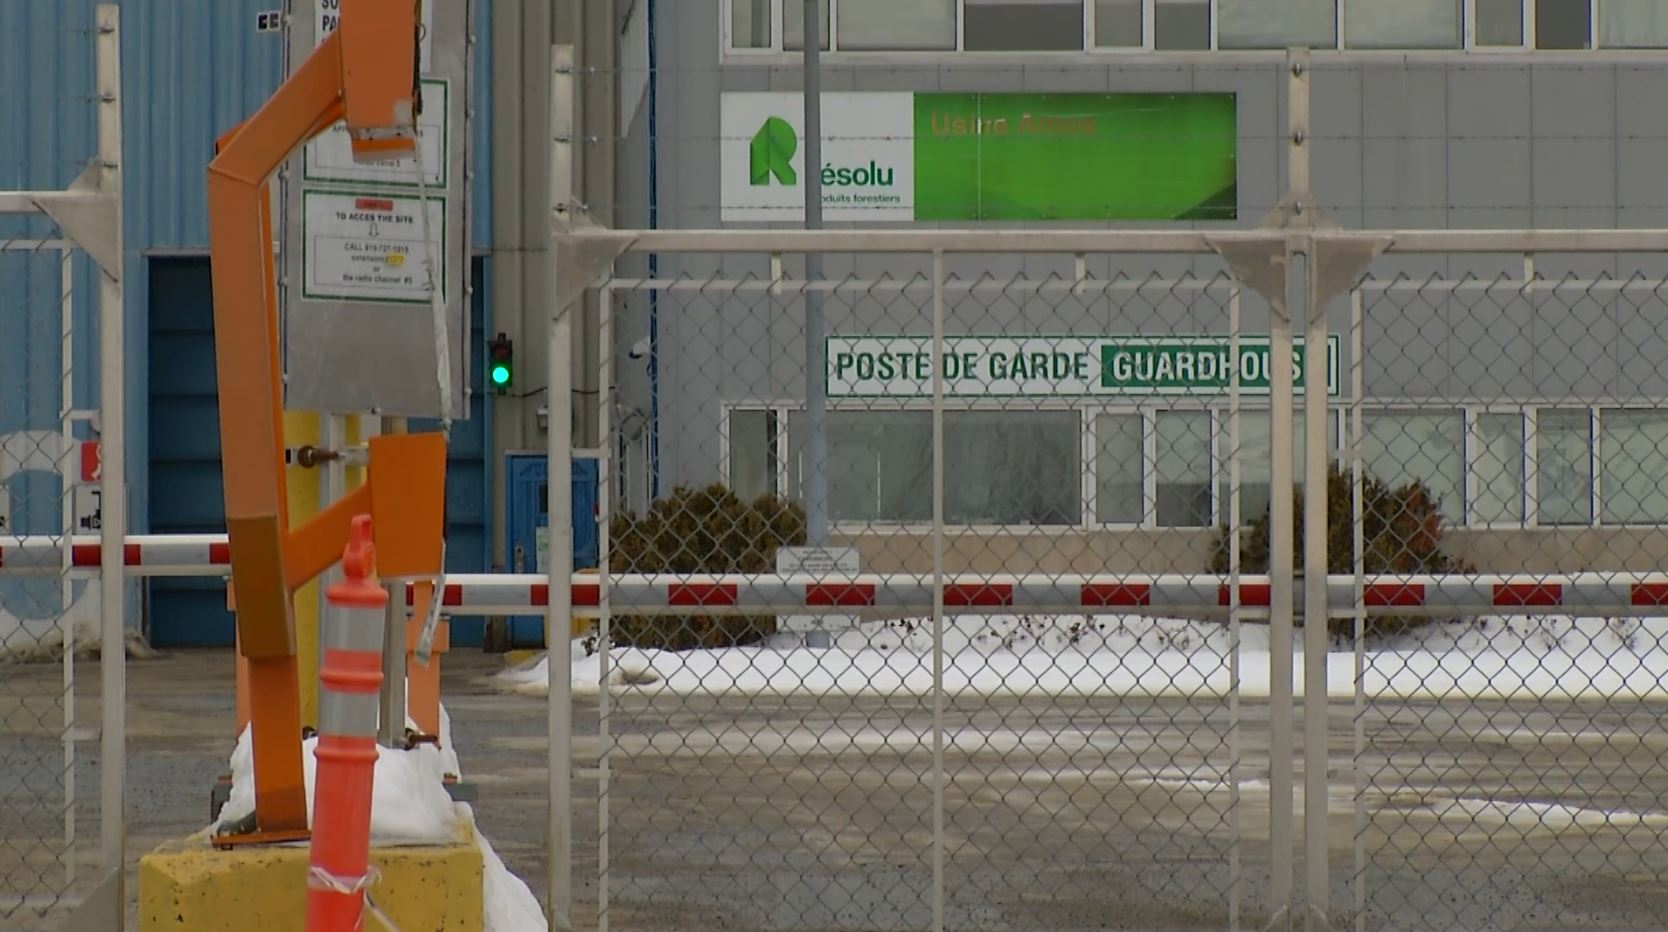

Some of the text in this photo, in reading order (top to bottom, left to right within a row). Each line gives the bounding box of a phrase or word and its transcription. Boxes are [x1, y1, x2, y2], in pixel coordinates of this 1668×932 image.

[930, 111, 1009, 136] Usine
[820, 160, 894, 186] ésolu
[821, 194, 901, 204] oduits forestiers
[336, 211, 413, 224] TO ACCES THE SITE
[344, 243, 362, 252] CALL
[836, 351, 1302, 381] POSTE DE GARDE GUARDHOUS
